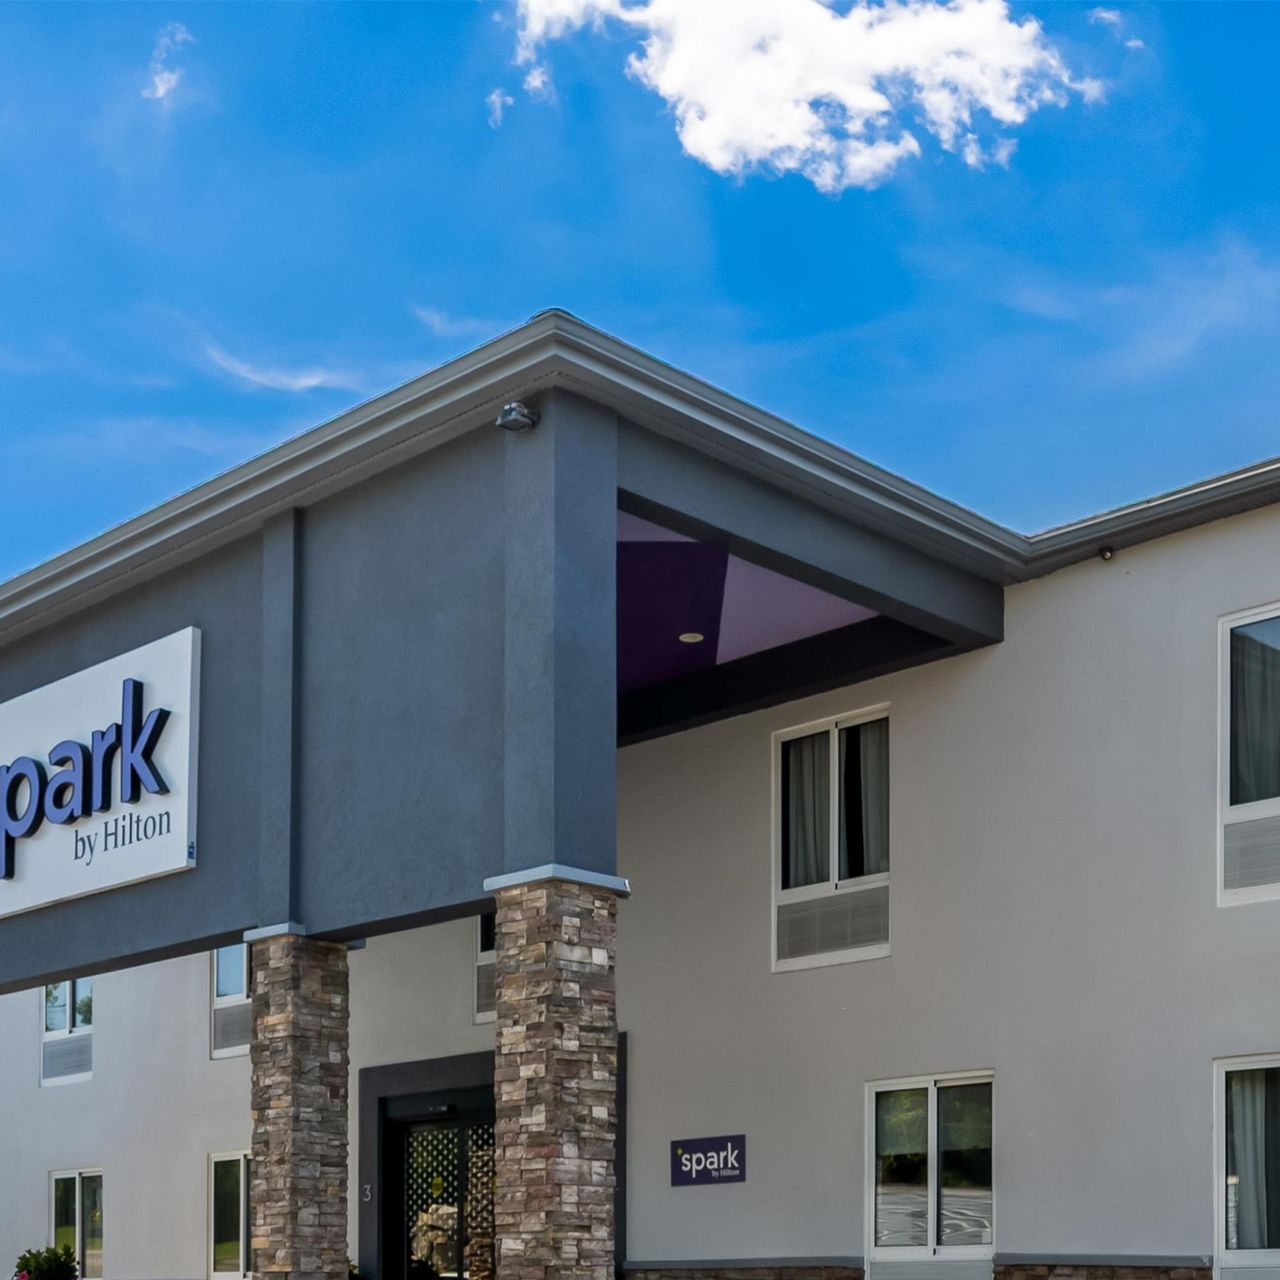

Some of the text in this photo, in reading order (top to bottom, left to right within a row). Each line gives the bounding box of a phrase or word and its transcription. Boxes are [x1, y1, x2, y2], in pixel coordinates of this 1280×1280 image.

[73, 811, 171, 866] by Hilton
[681, 1142, 739, 1179] spark
[363, 1185, 371, 1201] 3
